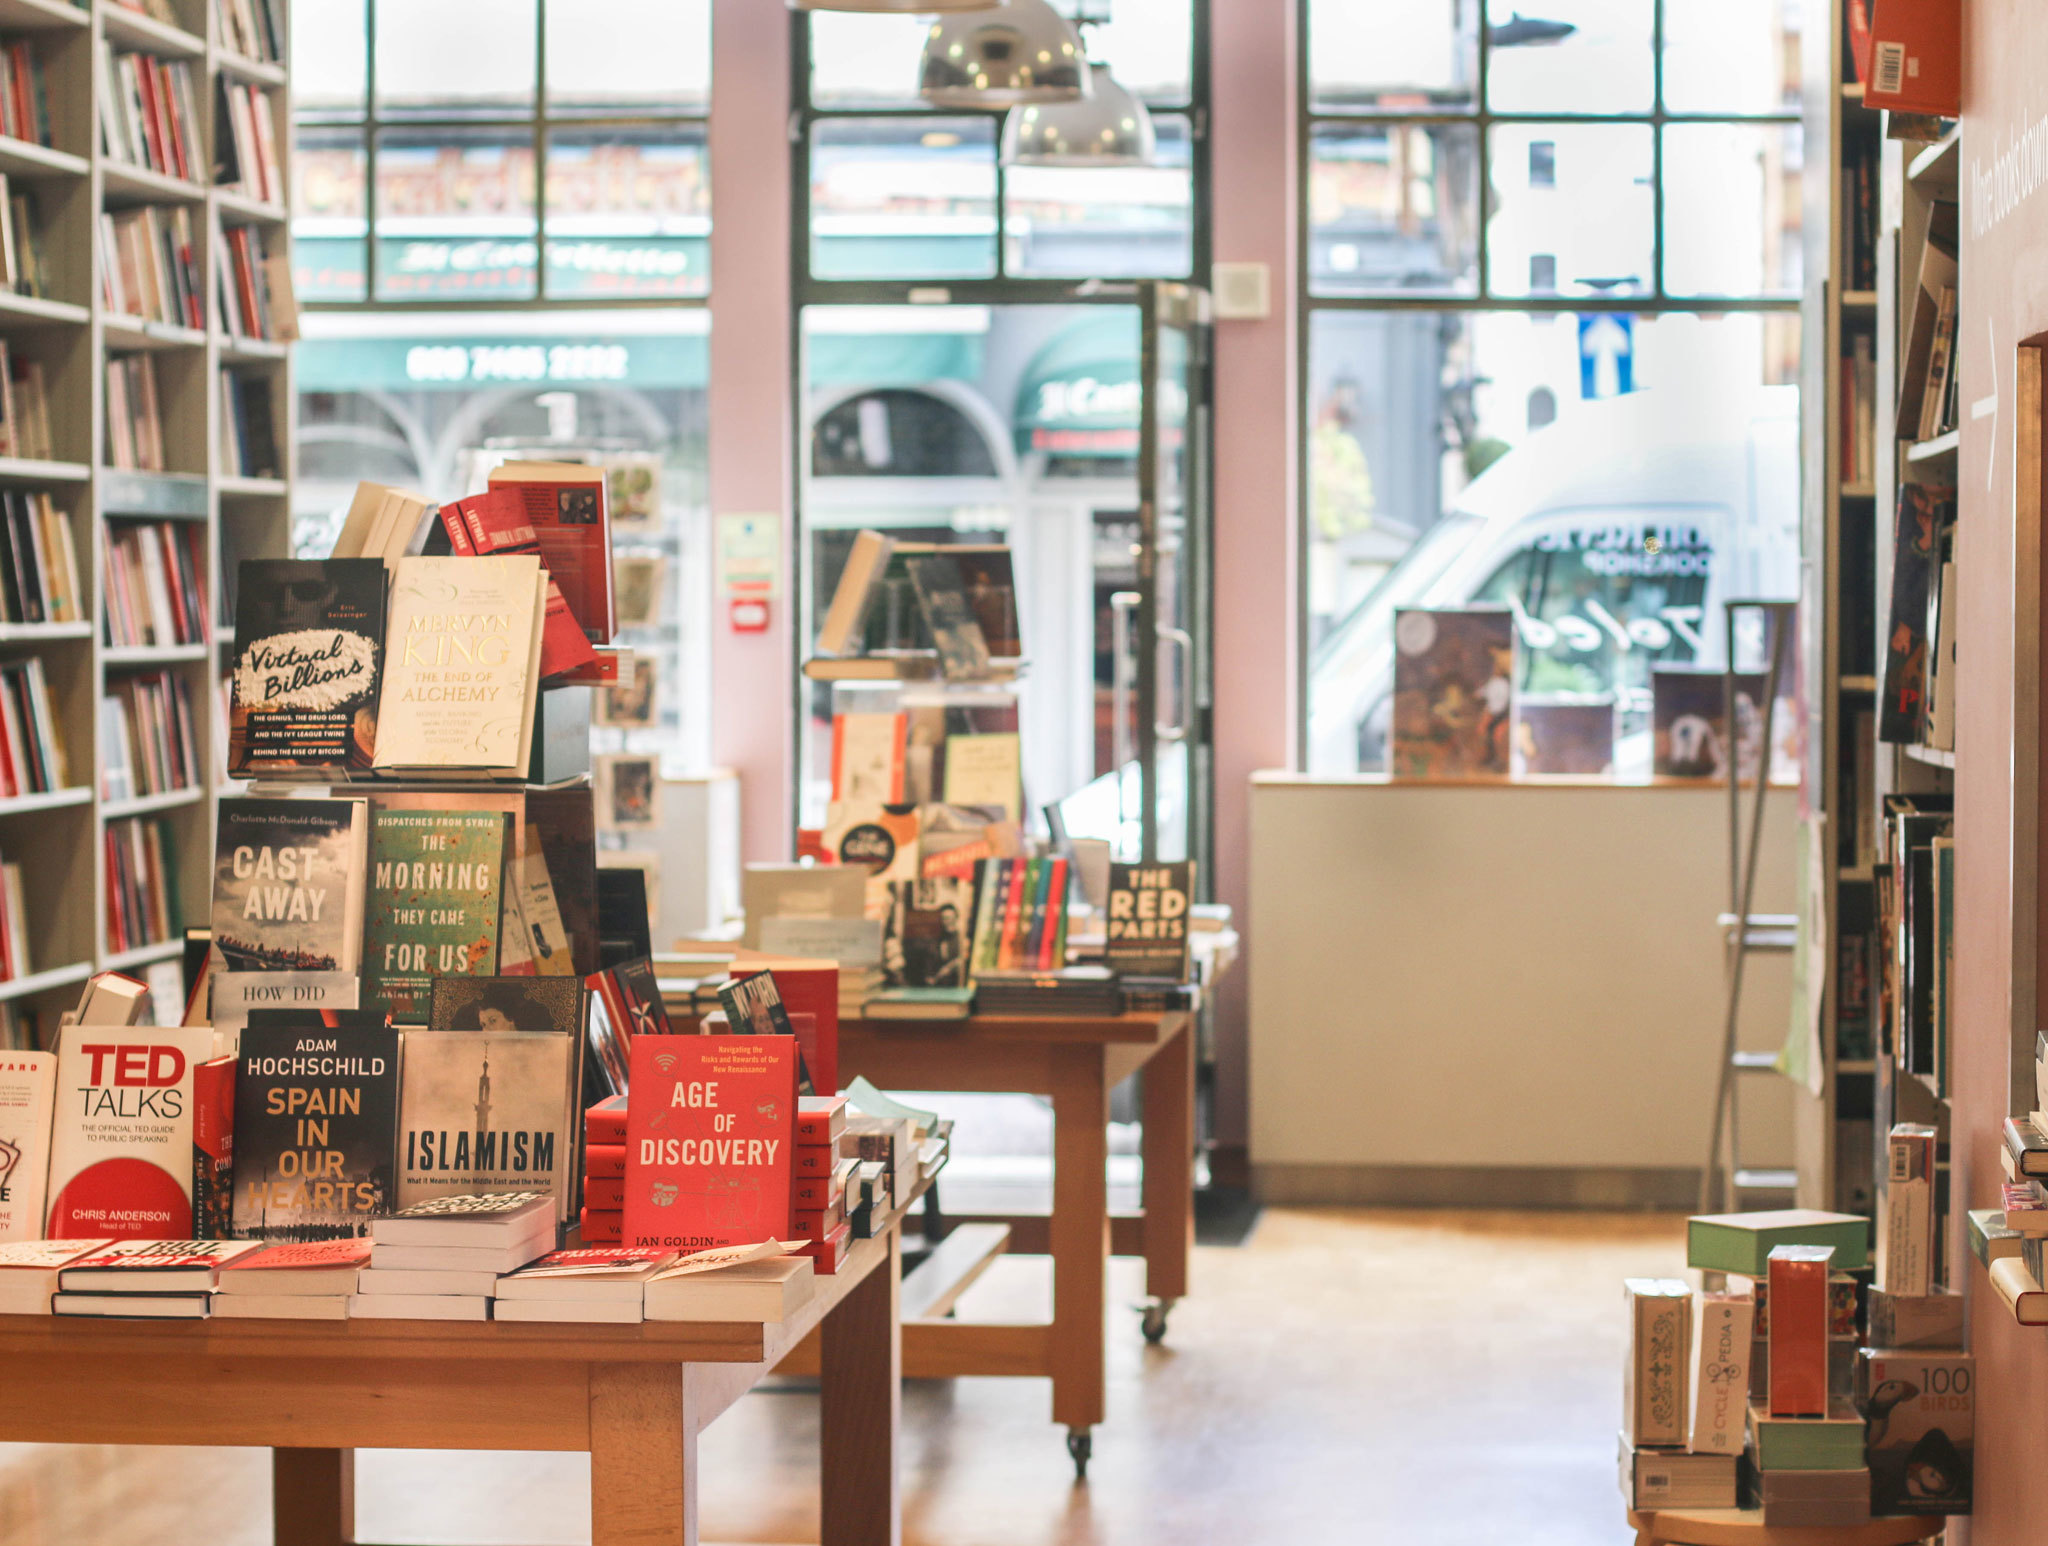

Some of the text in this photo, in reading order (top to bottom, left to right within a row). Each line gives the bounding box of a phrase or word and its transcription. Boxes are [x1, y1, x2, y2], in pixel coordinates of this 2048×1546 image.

[407, 615, 513, 633] MERVYN
[251, 633, 344, 673] Virtual
[400, 634, 511, 667] KING
[265, 658, 364, 701] Billions
[414, 672, 494, 682] THE END OF
[402, 686, 500, 702] ALCHEMY
[231, 813, 266, 824] Charlotte
[377, 817, 494, 827] DISPATCHES FROM SYRIA
[422, 835, 446, 851] THE
[233, 846, 319, 881] CAST
[376, 862, 489, 890] MORNING
[1129, 869, 1172, 889] THE
[243, 886, 326, 921] AWAY
[1110, 889, 1186, 919] RED
[394, 909, 465, 926] THEY CAME
[1109, 920, 1184, 939] PARTS
[385, 943, 468, 972] FOR US
[243, 985, 325, 1001] HOW DID
[295, 1039, 337, 1052] ADAM
[719, 1046, 763, 1055] Navigating the
[81, 1044, 186, 1087] TED
[248, 1057, 385, 1076] HOCHSCHILD
[78, 1088, 183, 1118] TALKS
[266, 1087, 360, 1115] SPAIN
[670, 1081, 718, 1108] AGE
[82, 1124, 175, 1134] THE OFFICIAL TED GUIDE
[297, 1119, 329, 1147] IN
[714, 1113, 736, 1133] OF
[87, 1134, 168, 1144] TO PUBLIC SPEAKING
[407, 1130, 555, 1172] ISLAMISM
[640, 1139, 779, 1166] DISCOVERY
[278, 1150, 345, 1179] OUR
[407, 1177, 422, 1185] What
[429, 1177, 448, 1185] Means
[460, 1177, 471, 1185] the
[472, 1177, 492, 1185] Middle
[533, 1178, 550, 1186] World
[247, 1181, 375, 1210] HEARTS
[72, 1209, 170, 1222] CHRIS ANDERSON
[100, 1222, 114, 1230] Head
[116, 1222, 125, 1230] of
[636, 1236, 659, 1247] IAN
[664, 1236, 714, 1247] GOLDIN
[1719, 1323, 1733, 1362] PEDIA
[1920, 1367, 1970, 1394] 100
[1713, 1387, 1729, 1430] CYCLE
[1920, 1397, 1970, 1411] BIRDS
